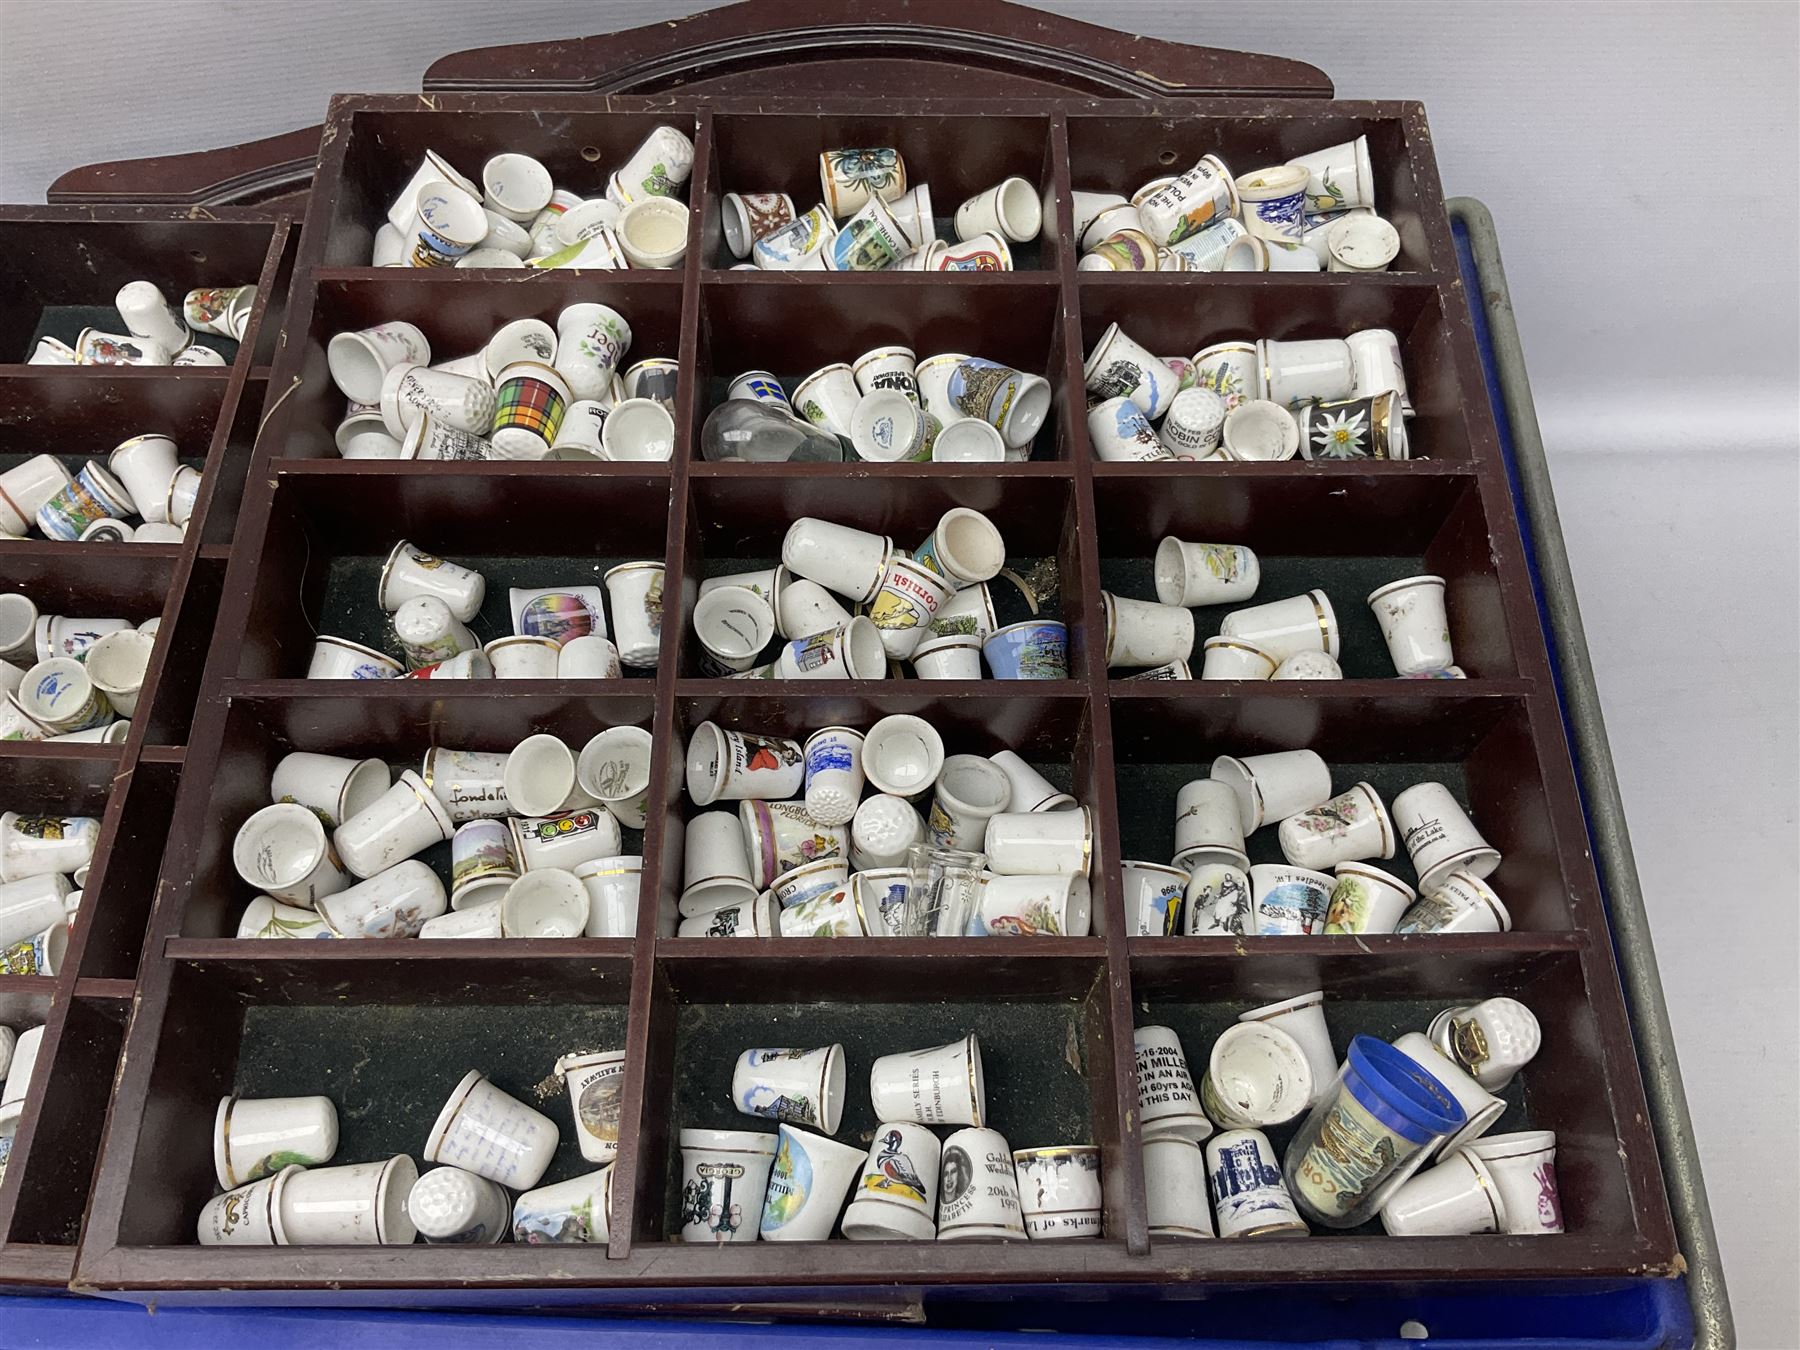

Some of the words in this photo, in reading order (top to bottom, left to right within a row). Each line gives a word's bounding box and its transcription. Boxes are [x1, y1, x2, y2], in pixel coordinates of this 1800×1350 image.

[869, 208, 897, 248] CATHEDRAL
[1167, 418, 1200, 444] ROBIN
[893, 572, 938, 612] Cornish
[733, 744, 744, 776] Island
[780, 811, 818, 829] FLORIDA
[1425, 826, 1443, 837] Lake
[1295, 875, 1327, 889] Needles
[1160, 885, 1177, 896] 1998
[580, 1066, 617, 1090] RAILWAY
[1159, 1070, 1172, 1078] AN
[912, 1068, 921, 1100] SERIES
[1150, 1082, 1178, 1092] 60yrs
[933, 1070, 943, 1117] EDINBURGH
[1145, 1093, 1169, 1105] THIS
[1173, 1092, 1191, 1101] DAY
[699, 1166, 743, 1177] GEORGIA
[987, 1185, 1009, 1197] 20th
[1042, 1219, 1056, 1231] of
